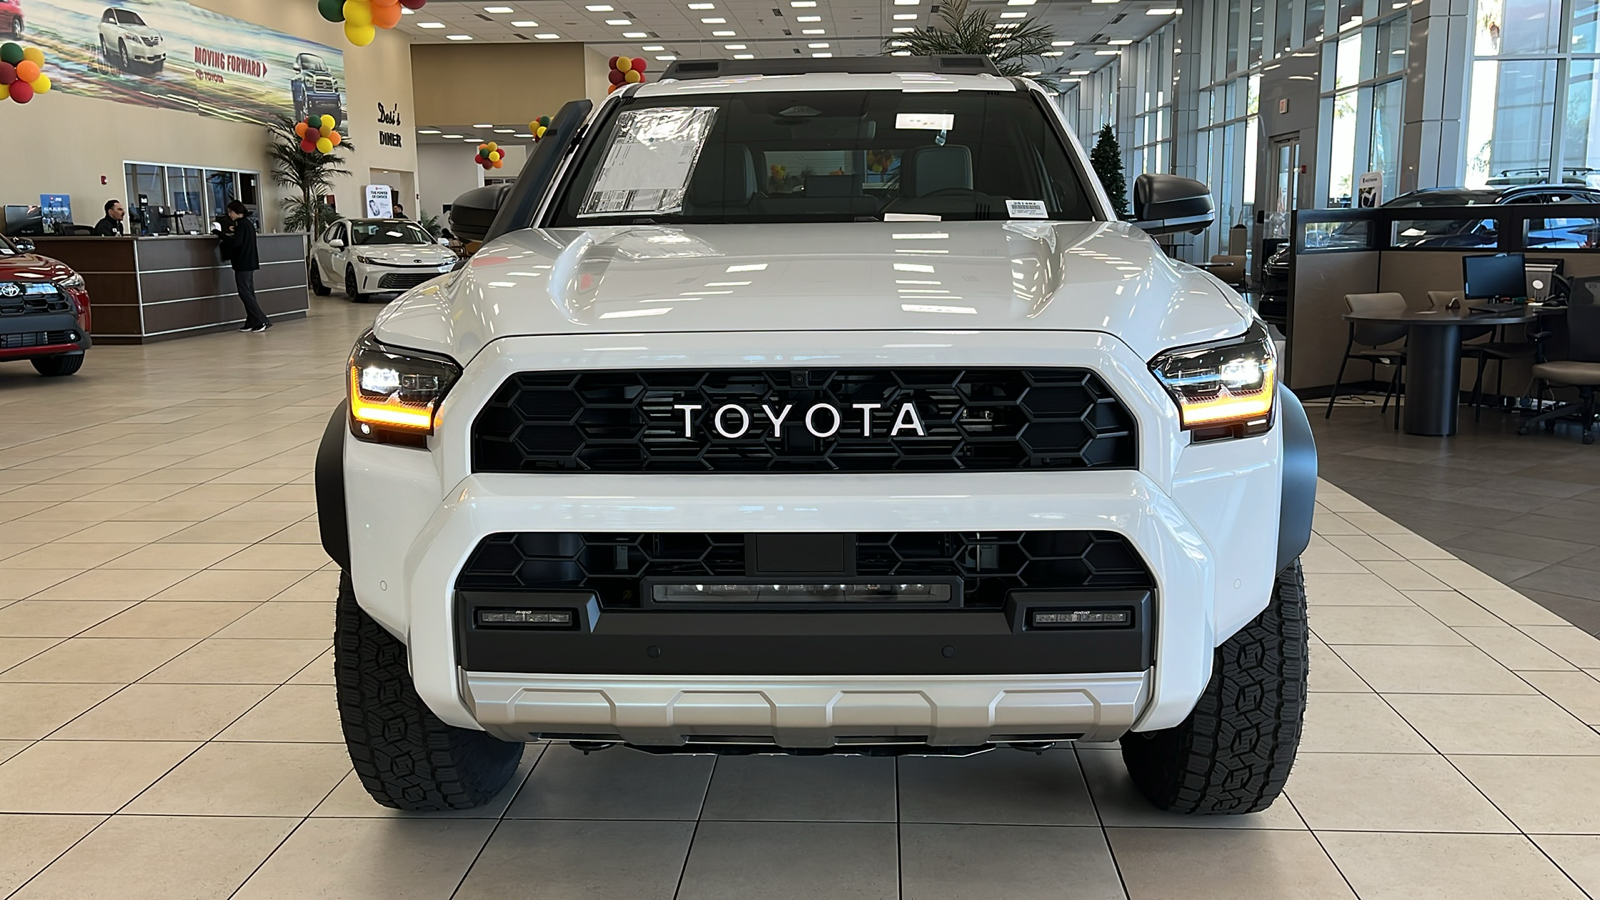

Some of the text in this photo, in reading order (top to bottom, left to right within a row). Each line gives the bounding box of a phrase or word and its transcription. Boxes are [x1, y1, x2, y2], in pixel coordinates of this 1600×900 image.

[194, 46, 261, 78] MOVING FORWARD
[204, 71, 224, 83] TOYOTA
[379, 130, 402, 148] DINER
[674, 403, 925, 438] TOYOTA
